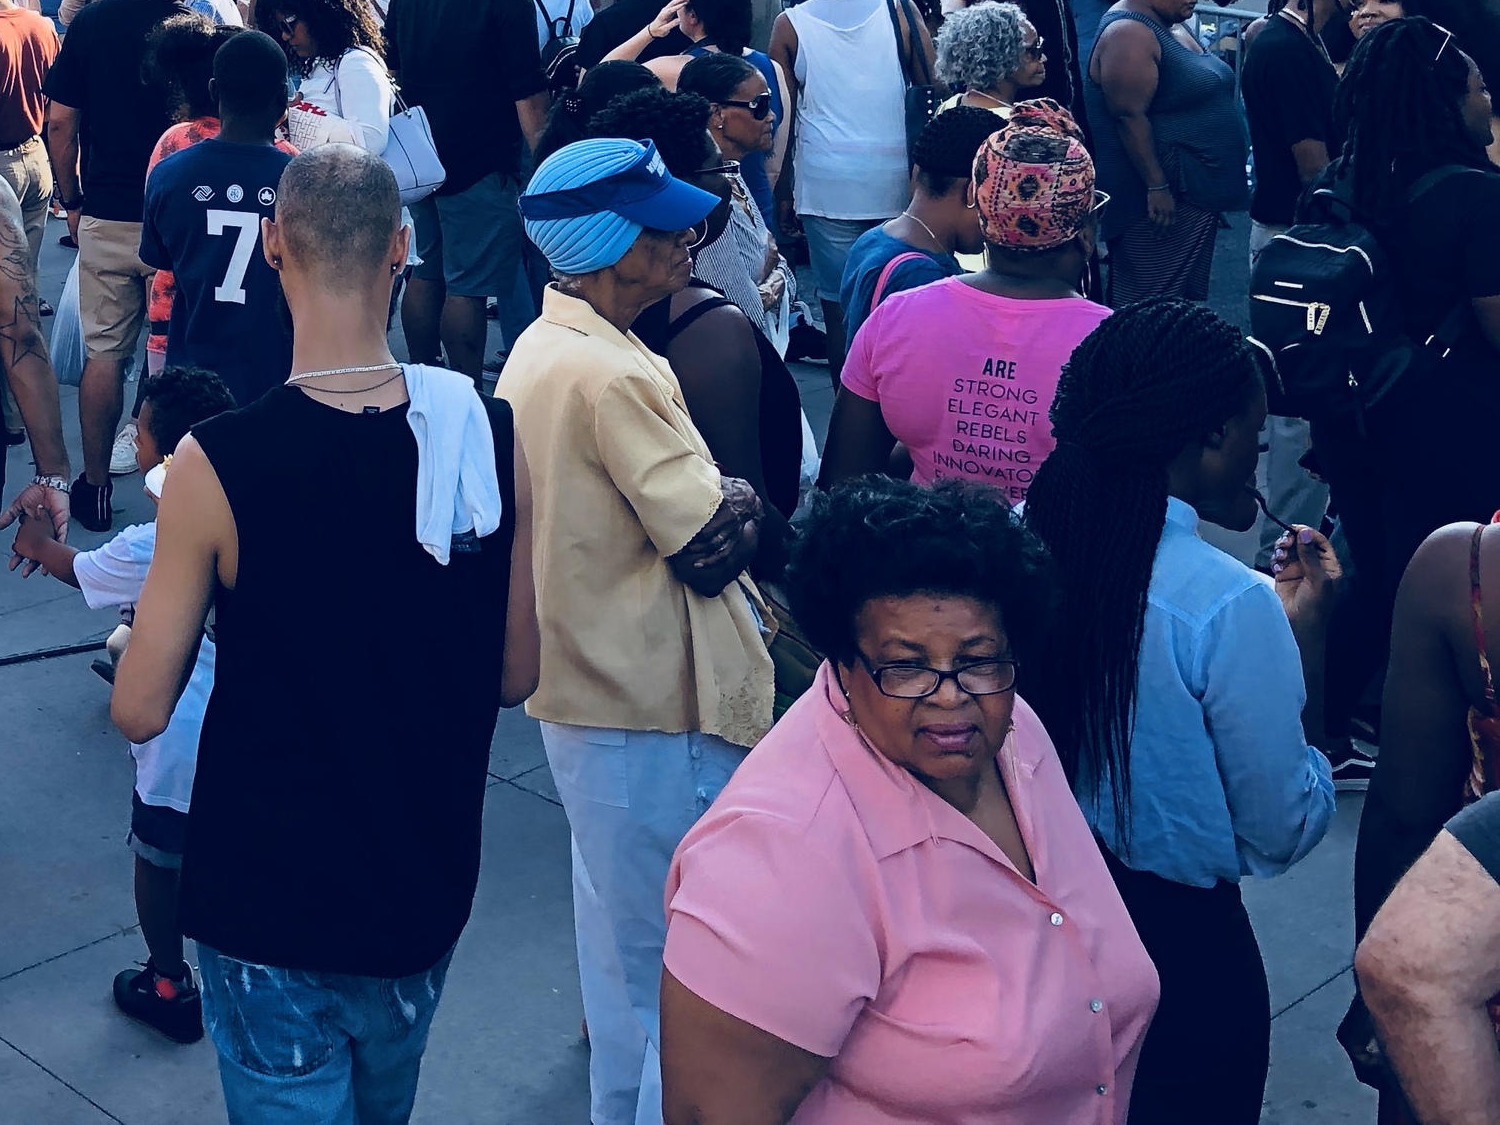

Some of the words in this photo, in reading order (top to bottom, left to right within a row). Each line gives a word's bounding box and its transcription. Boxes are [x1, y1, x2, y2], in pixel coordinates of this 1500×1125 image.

[206, 208, 260, 305] 7
[982, 357, 1017, 380] ARE
[953, 378, 1038, 405] STRONG
[947, 398, 1040, 426] ELEGANT
[957, 420, 1028, 444] REBELS
[952, 438, 1031, 464] DARING
[933, 450, 1034, 483] INNOVATO
